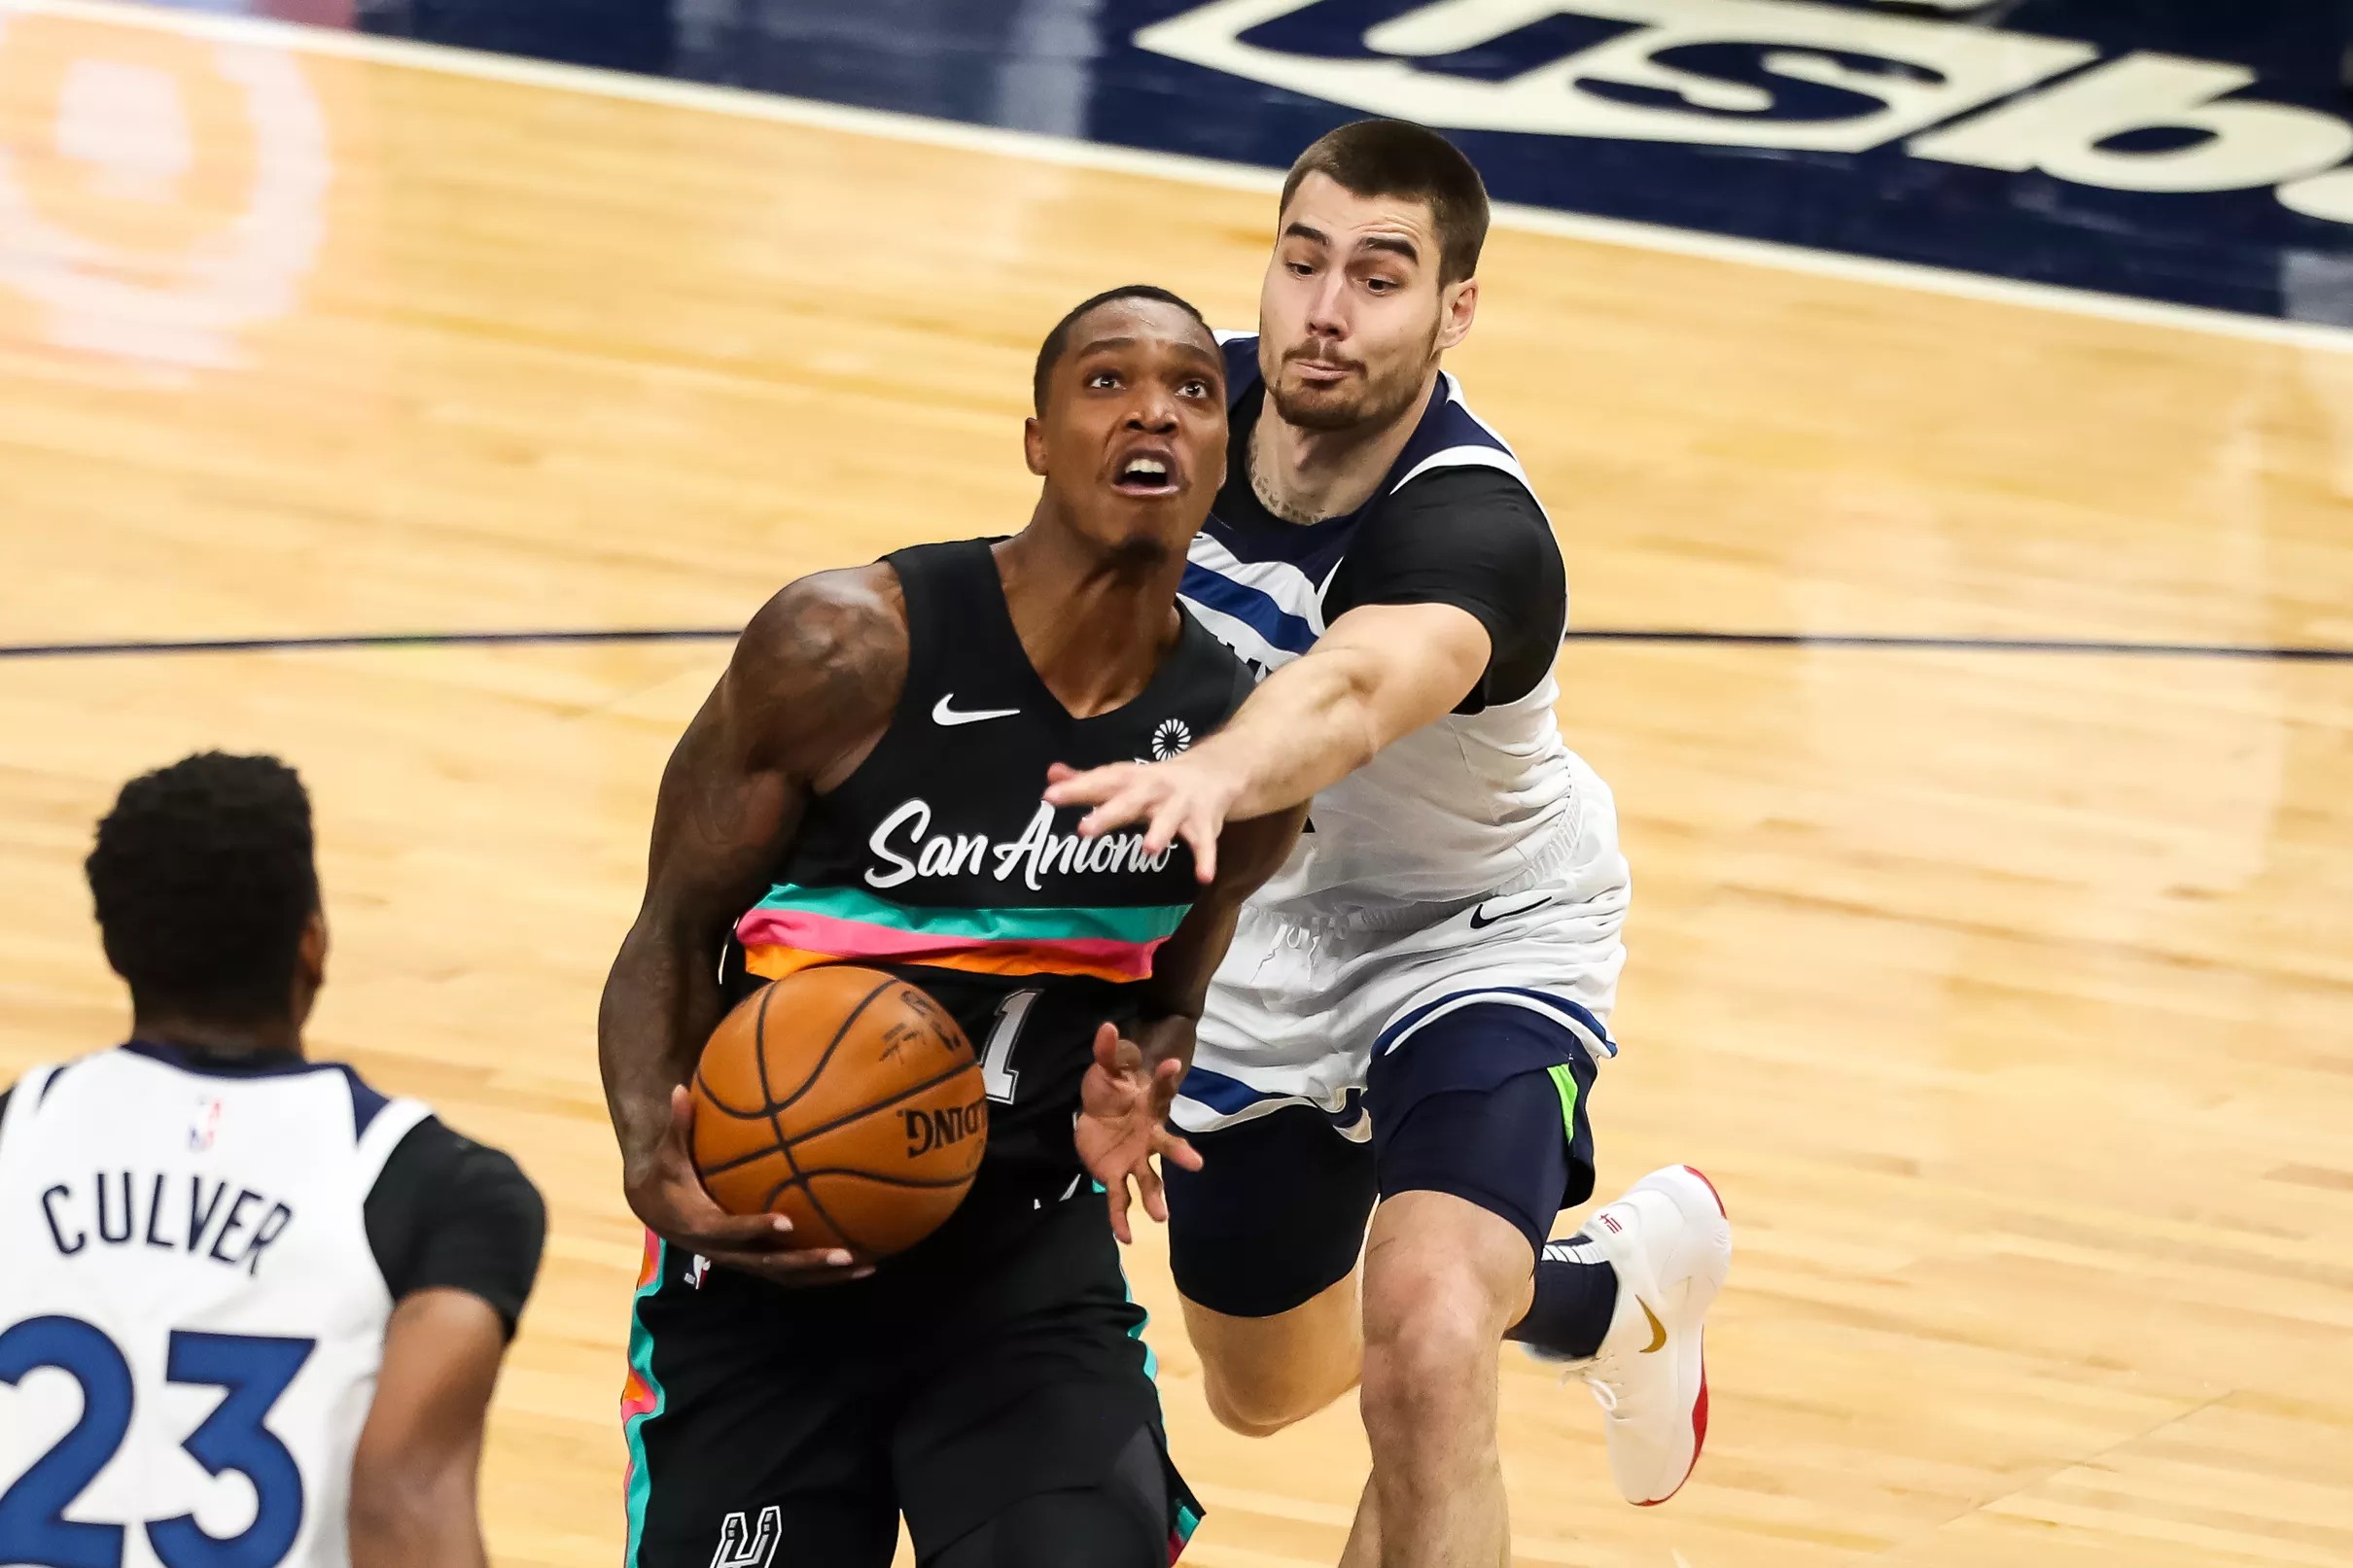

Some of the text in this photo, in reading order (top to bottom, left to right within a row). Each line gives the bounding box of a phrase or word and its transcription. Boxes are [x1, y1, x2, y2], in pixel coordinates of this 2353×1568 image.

[864, 797, 988, 889] San
[980, 989, 1044, 1104] 1
[42, 1171, 294, 1276] CULVER
[0, 1315, 304, 1568] 23
